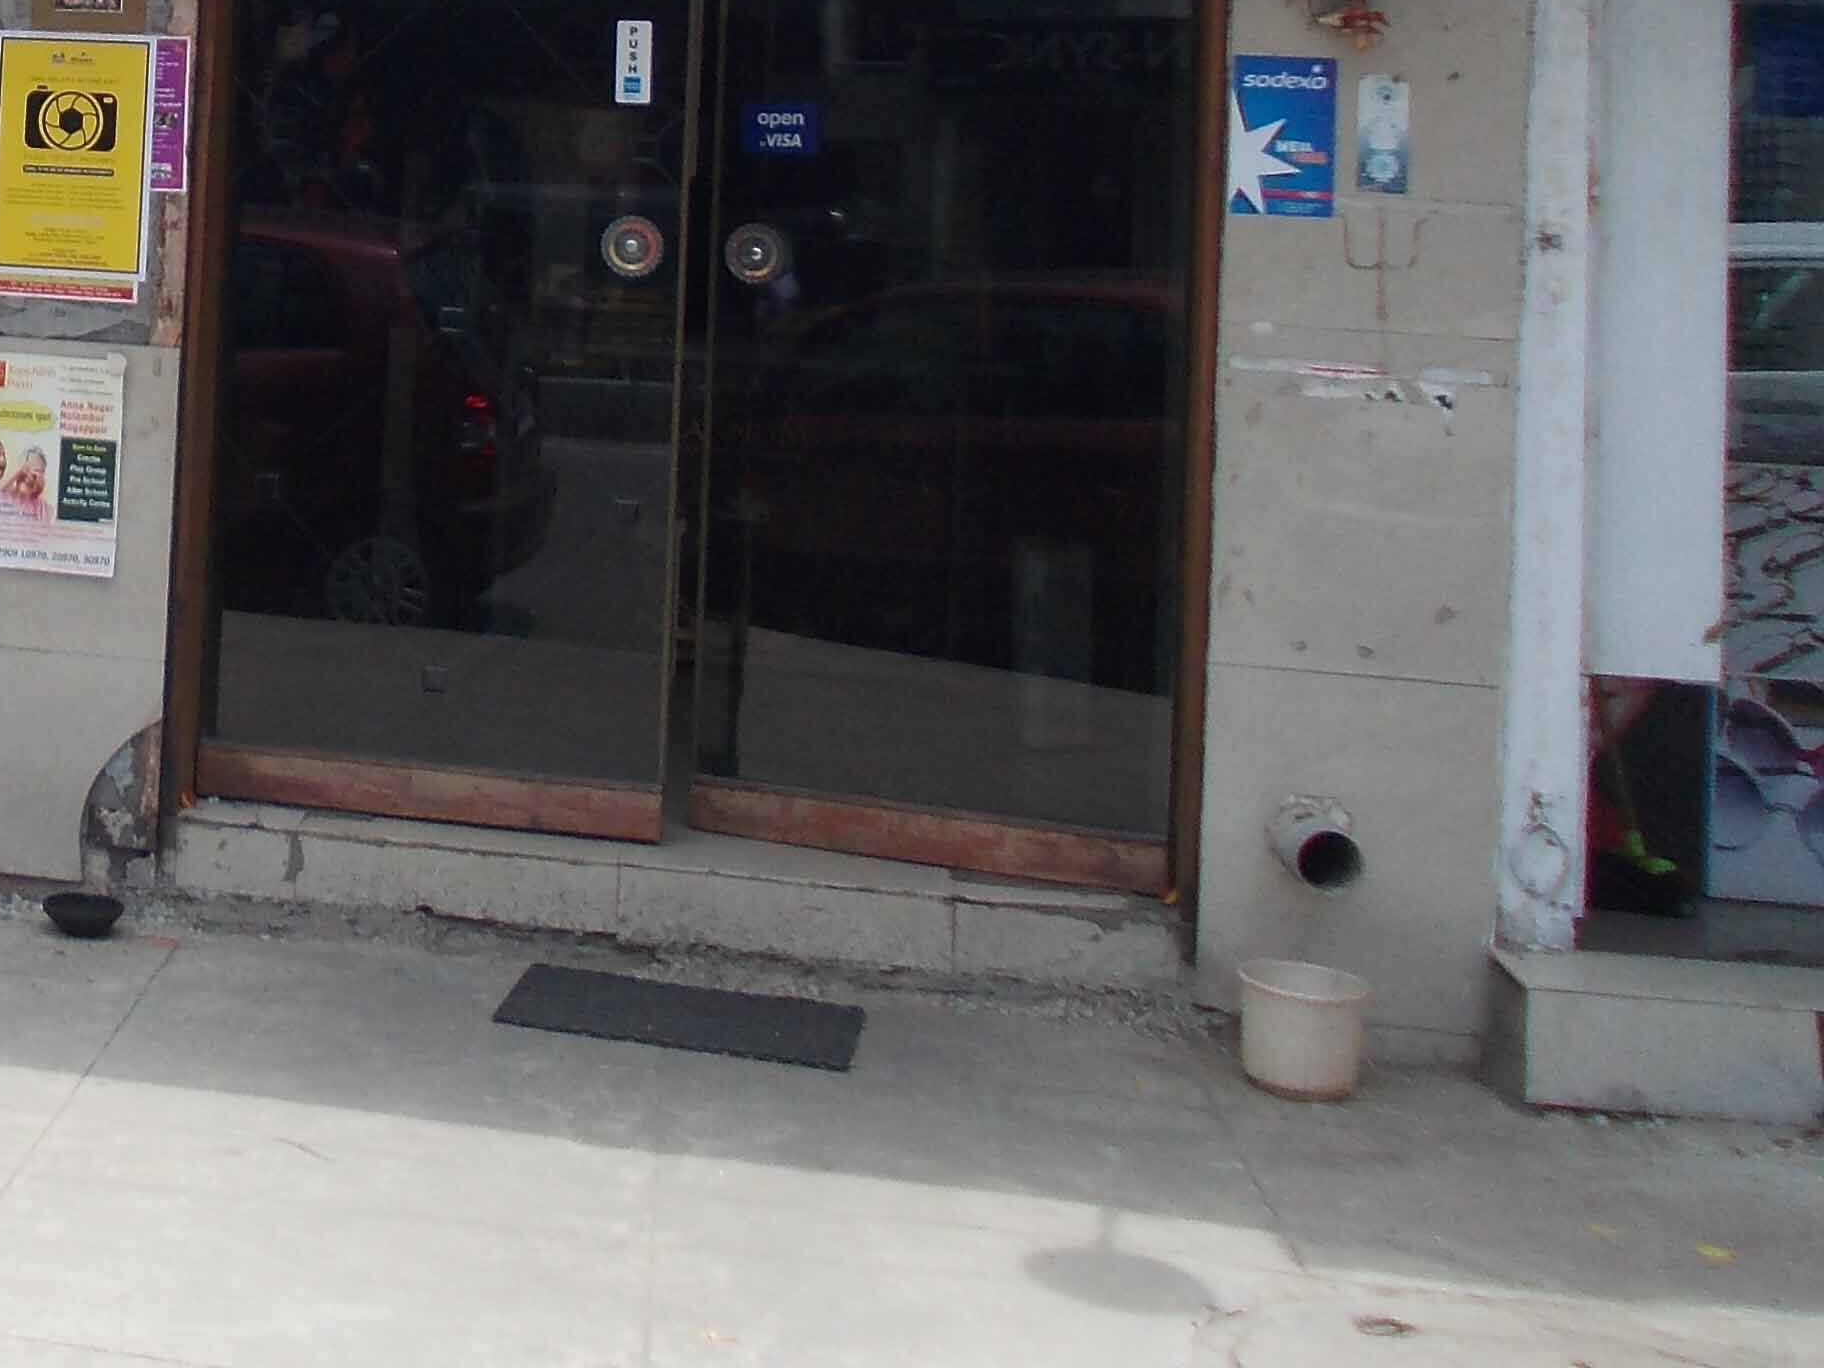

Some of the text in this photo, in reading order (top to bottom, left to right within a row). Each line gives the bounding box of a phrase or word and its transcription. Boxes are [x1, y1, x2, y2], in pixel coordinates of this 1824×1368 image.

[628, 25, 638, 73] PUSH
[1242, 70, 1329, 90] sodexo
[757, 111, 805, 129] open
[766, 133, 803, 148] VISA
